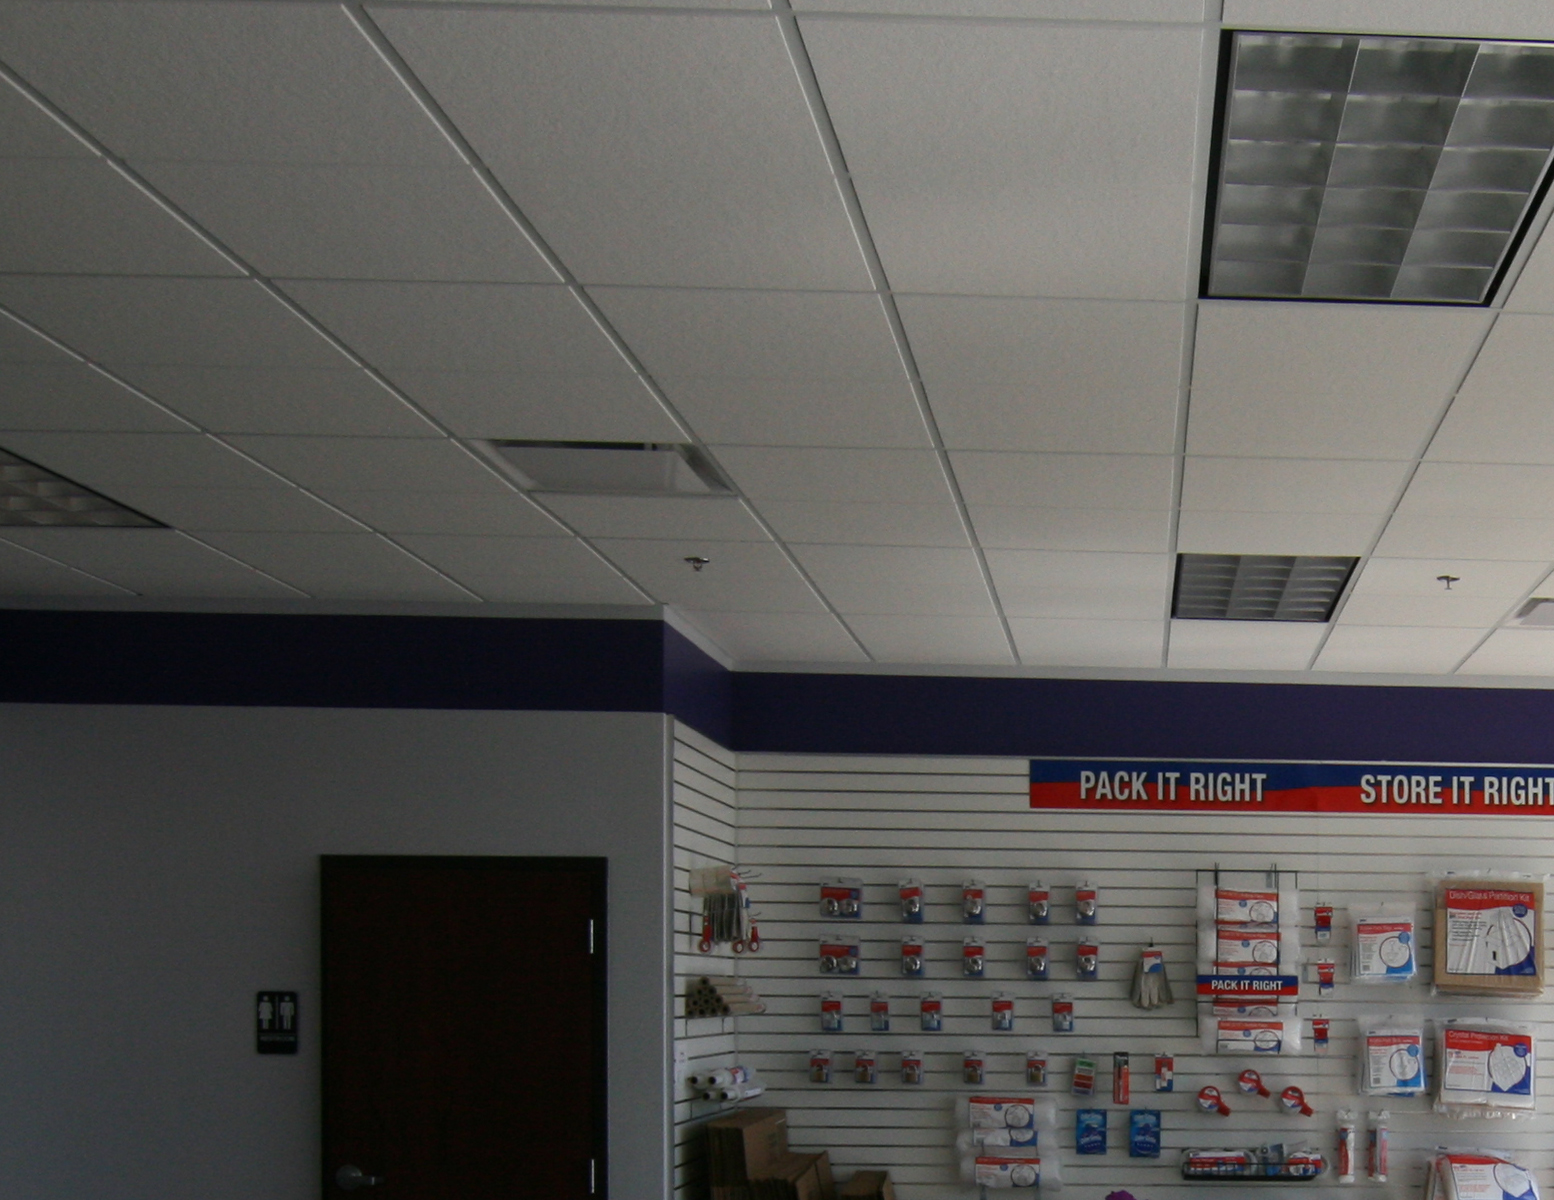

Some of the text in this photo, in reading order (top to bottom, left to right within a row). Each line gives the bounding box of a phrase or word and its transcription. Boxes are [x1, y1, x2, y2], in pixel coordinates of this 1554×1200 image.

[1079, 770, 1267, 803] PACK IT RIGHT
[1360, 774, 1442, 804] STORE
[1450, 775, 1475, 805] IT
[1211, 980, 1283, 991] PACK IT RIGHT
